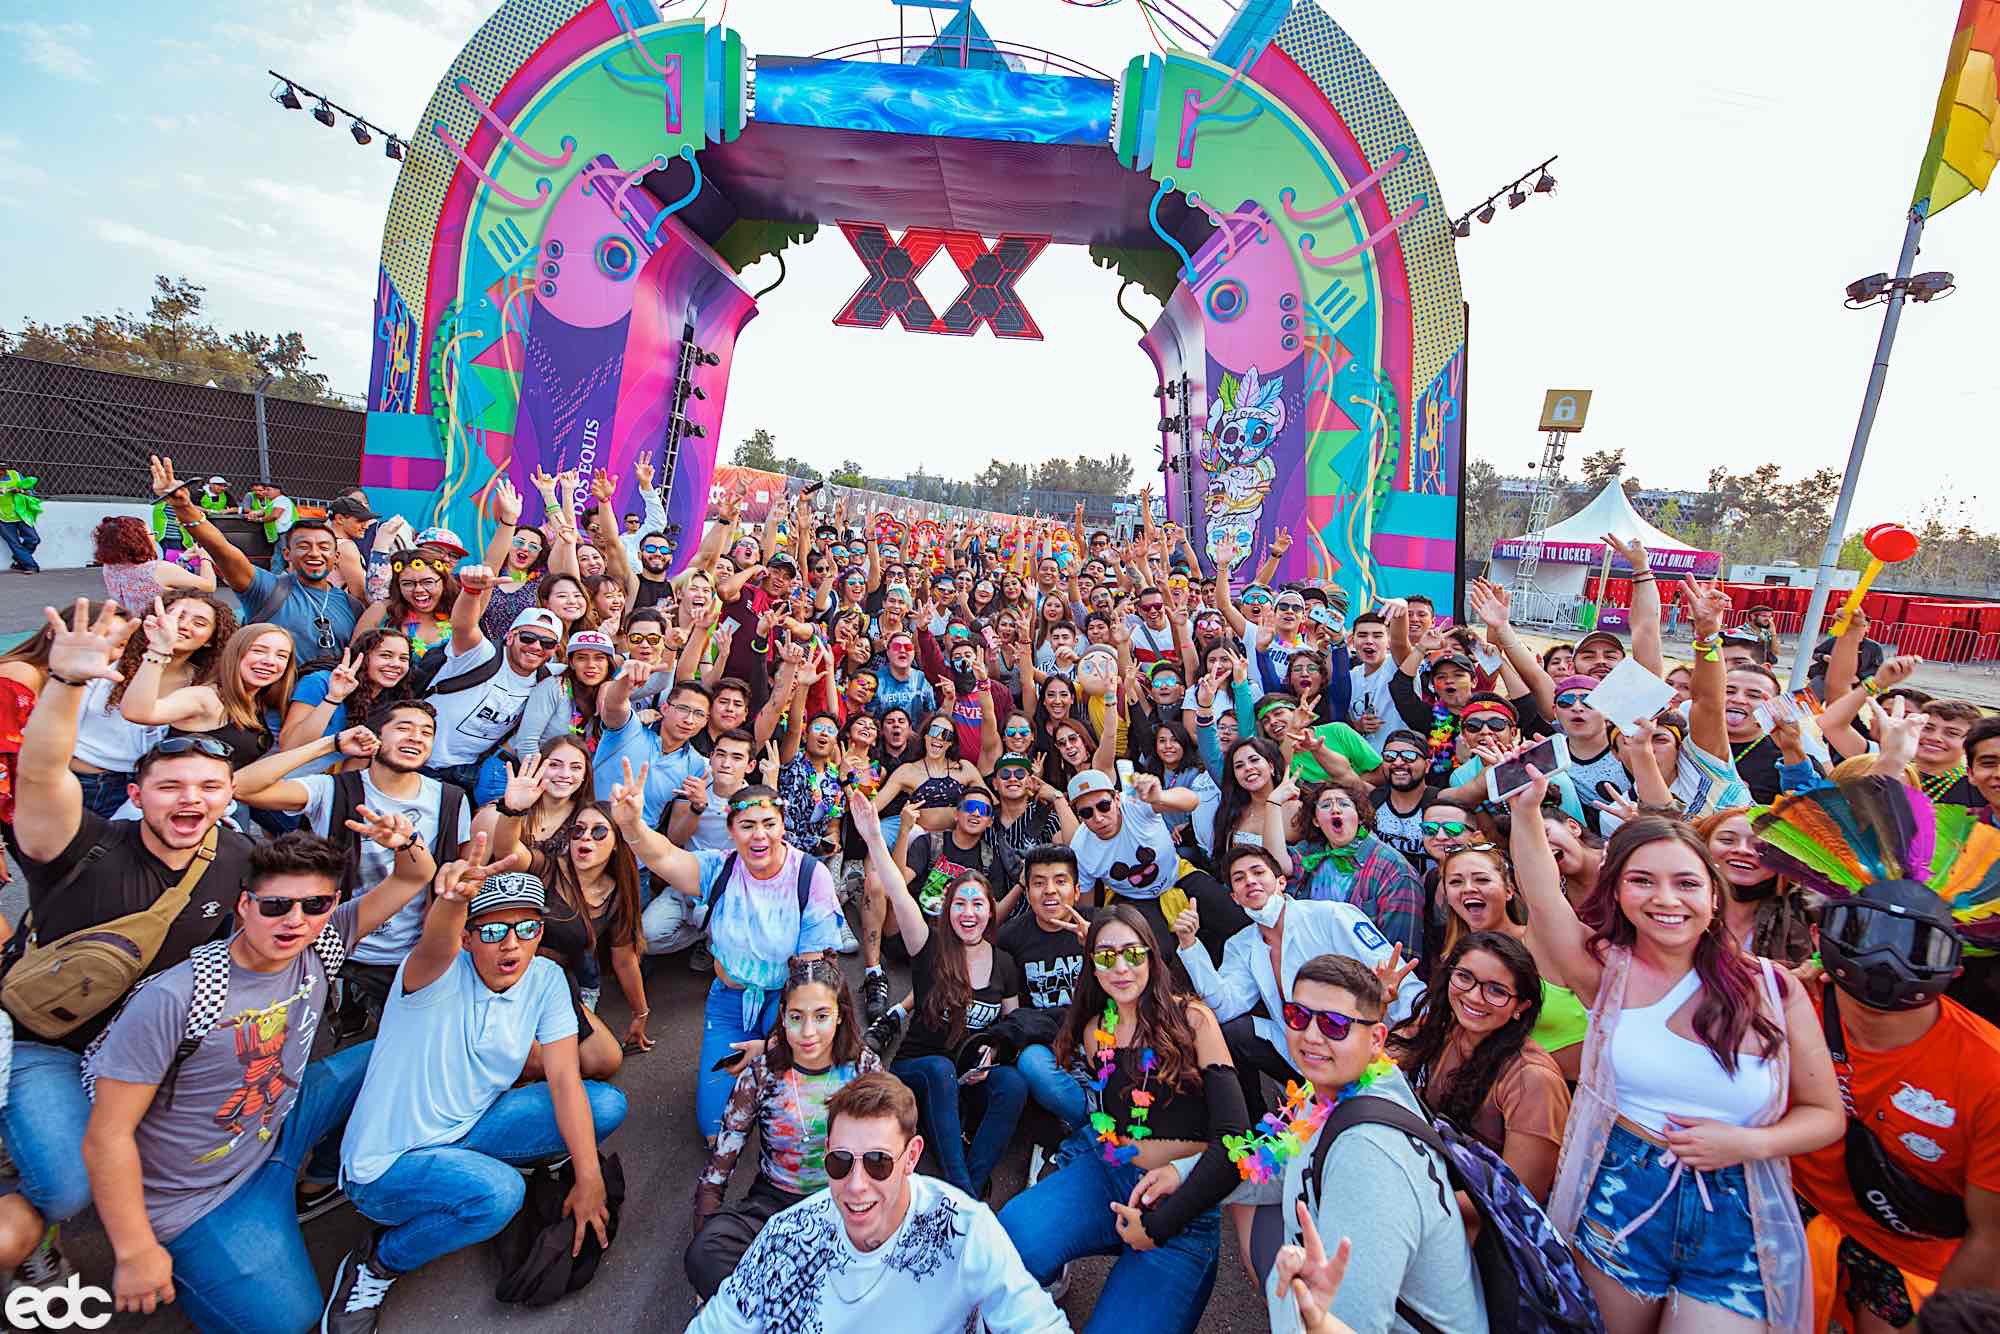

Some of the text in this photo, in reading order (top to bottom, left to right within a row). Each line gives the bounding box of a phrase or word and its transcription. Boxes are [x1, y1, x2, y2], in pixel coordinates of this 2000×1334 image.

[579, 418, 600, 474] EQUIS
[1546, 546, 1557, 560] TU
[1558, 547, 1592, 562] LOCKER
[1667, 554, 1697, 569] ONLINE
[1602, 614, 1621, 625] edc
[1024, 955, 1083, 978] BLAH
